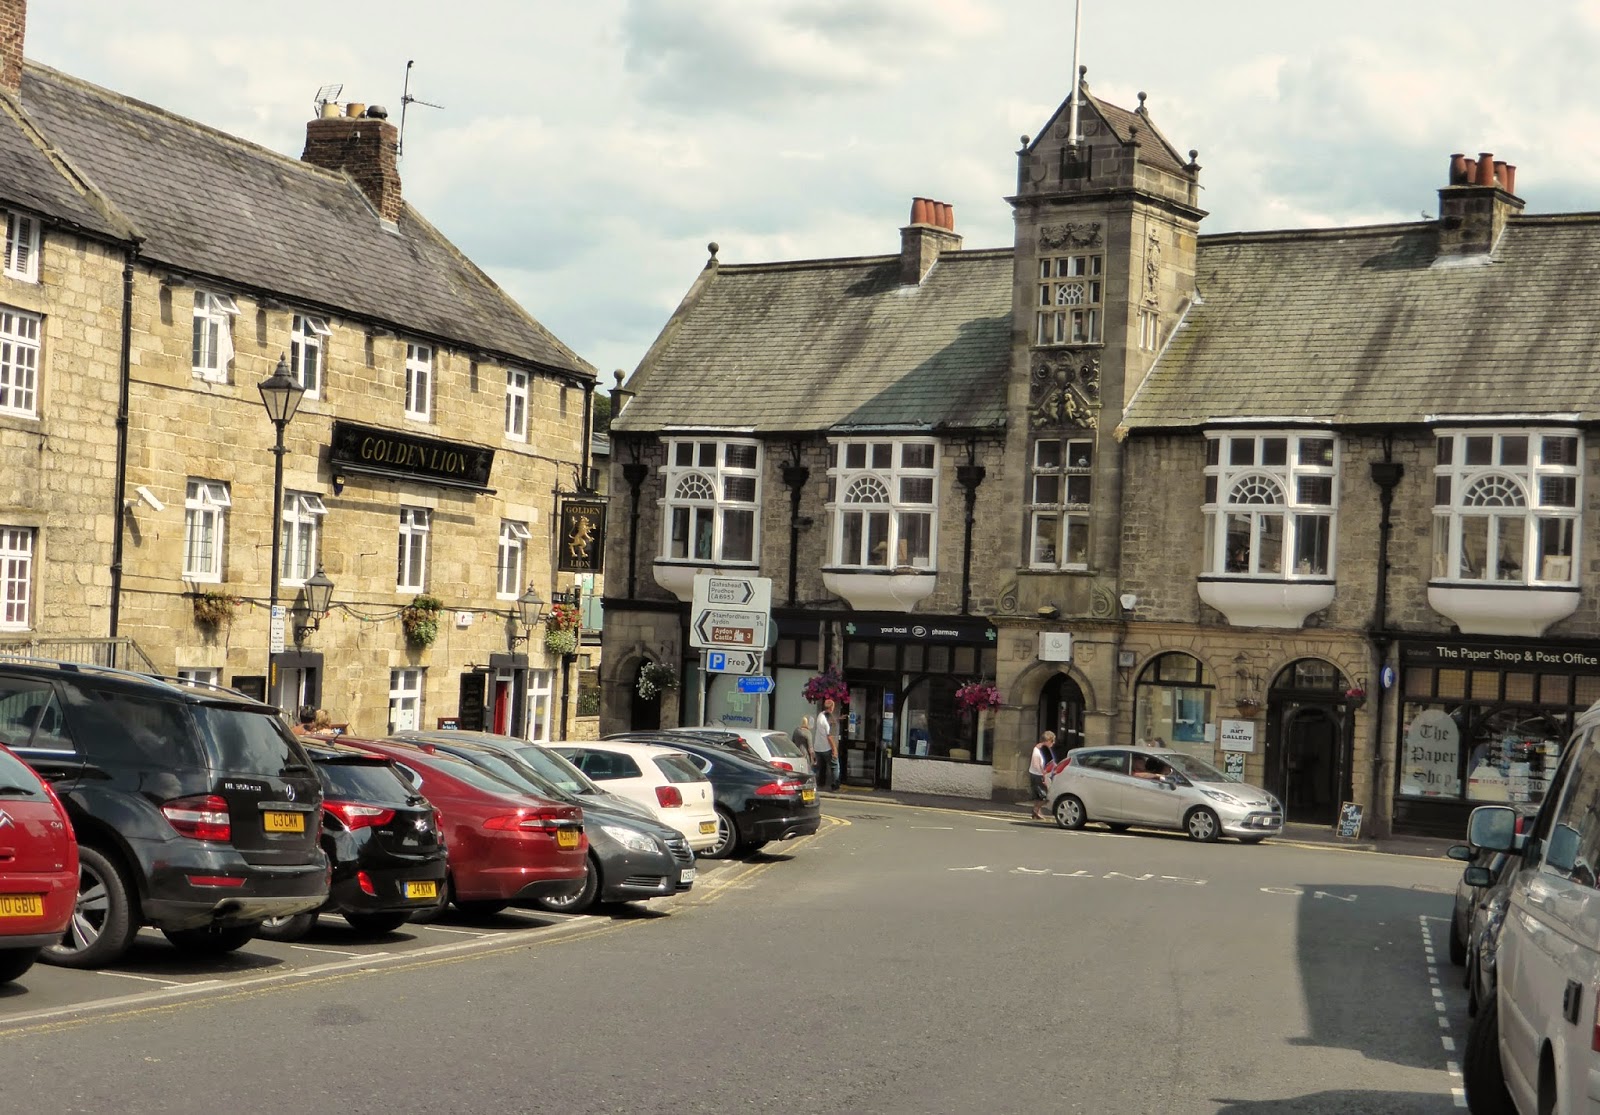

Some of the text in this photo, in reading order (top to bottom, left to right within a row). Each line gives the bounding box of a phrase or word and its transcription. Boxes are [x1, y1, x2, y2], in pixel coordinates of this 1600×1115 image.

[361, 436, 468, 473] GOLDEN LION
[565, 506, 600, 514] GOLDEN
[570, 560, 591, 568] LION
[712, 612, 750, 620] Stamfordham
[715, 628, 733, 636] Aydon
[894, 626, 907, 634] local
[931, 629, 959, 637] pharmacy
[1436, 646, 1597, 665] The Paper Shop & Post Office
[728, 658, 746, 666] Free
[722, 713, 753, 723] pharmacy
[1419, 724, 1449, 741] The
[1411, 746, 1457, 764] Paper
[1412, 769, 1452, 788] Shop
[14, 896, 36, 913] GBU
